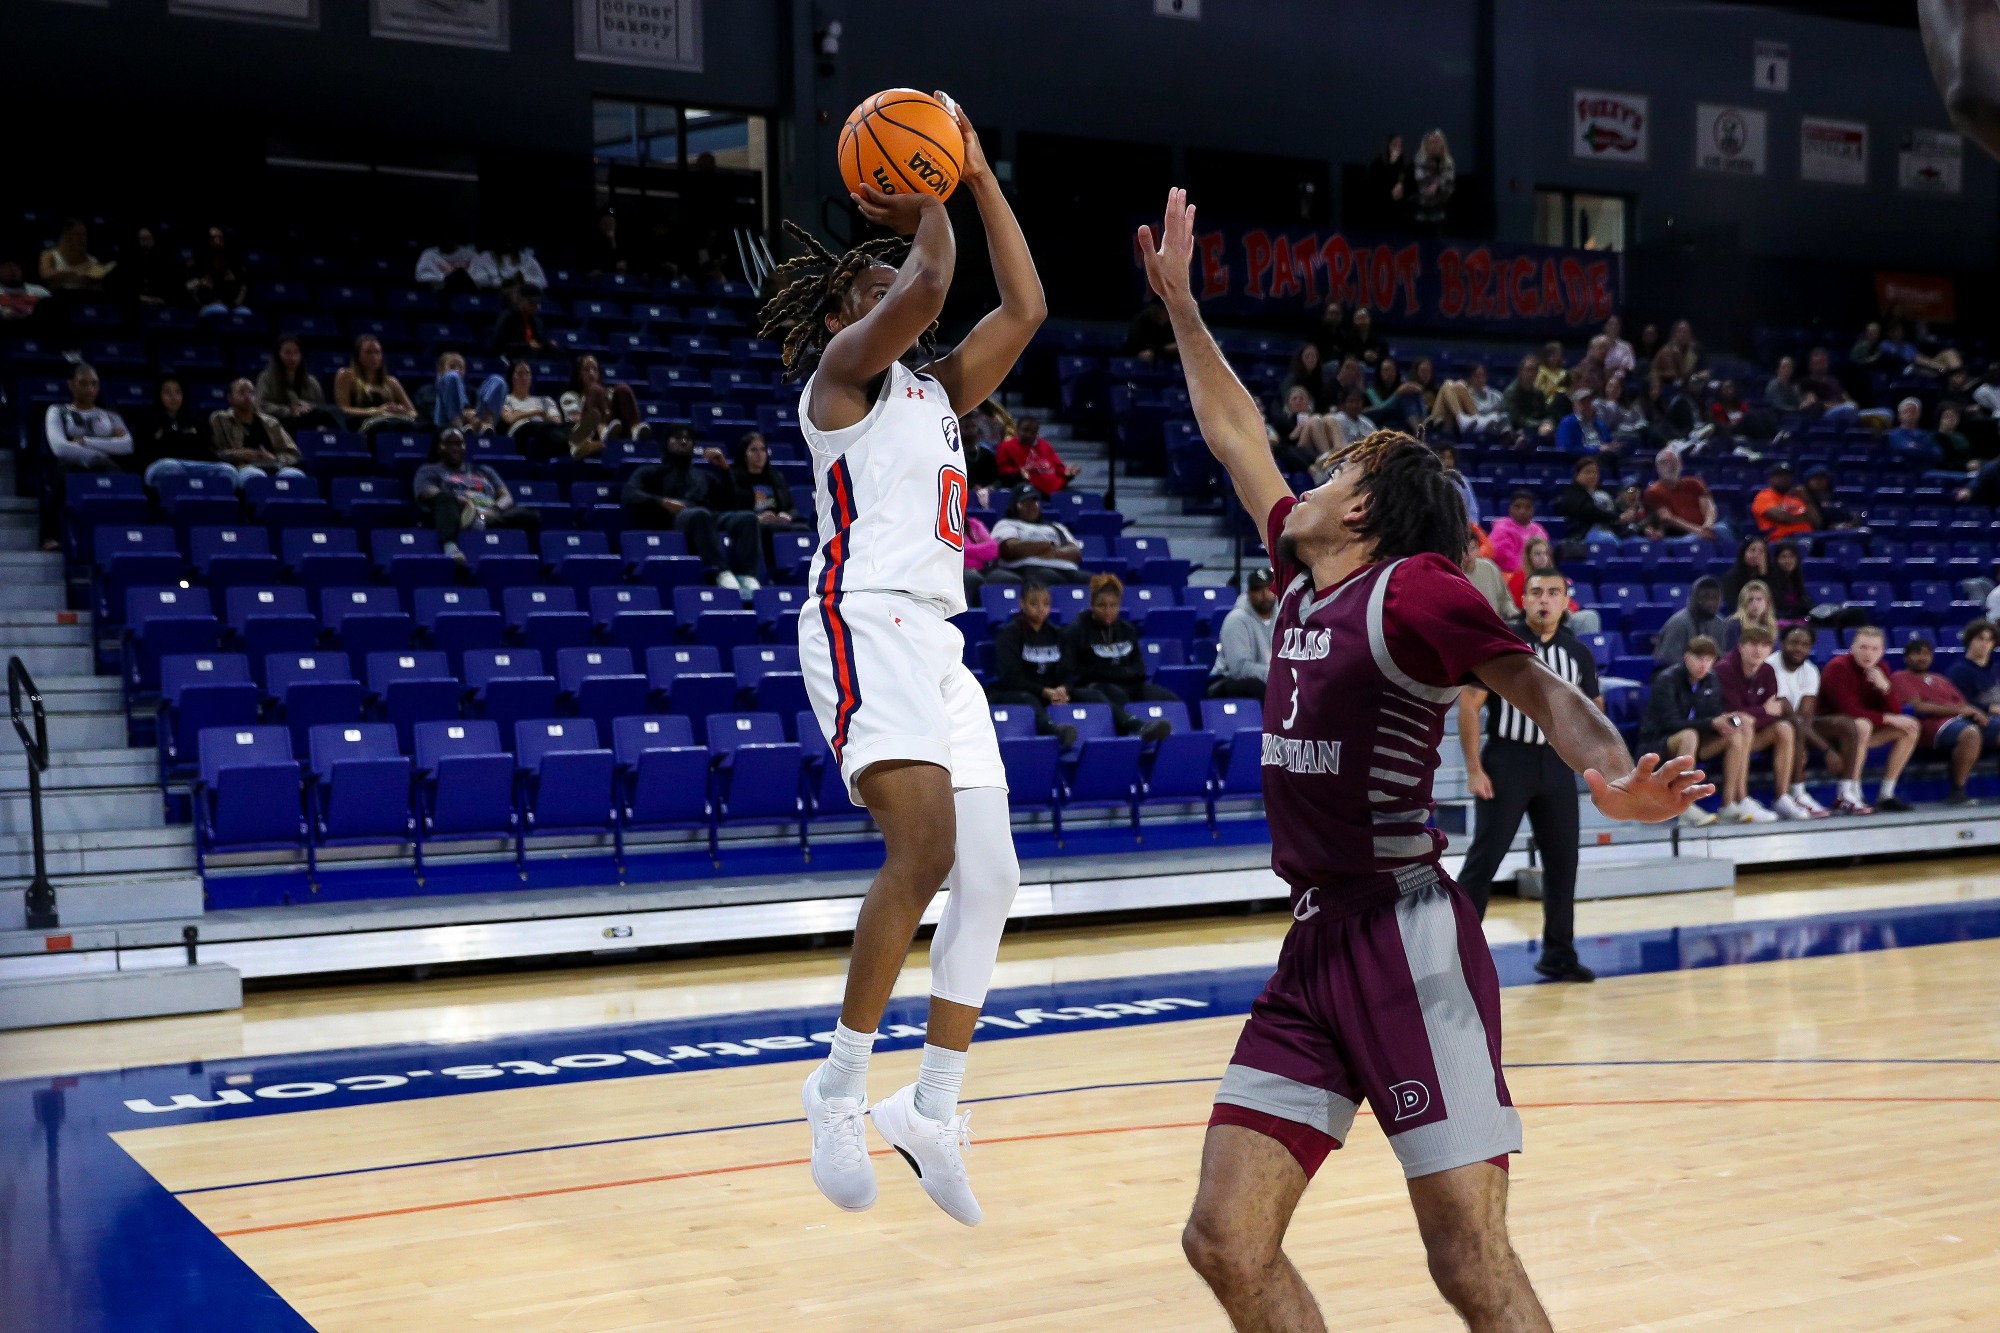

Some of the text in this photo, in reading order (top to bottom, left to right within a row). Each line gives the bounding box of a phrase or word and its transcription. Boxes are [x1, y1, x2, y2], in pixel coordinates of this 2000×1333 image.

[907, 151, 951, 196] NCAA
[1241, 230, 1423, 316] PATRIOT
[1436, 246, 1614, 325] BRIGADE
[123, 997, 1209, 1114] uttylratriots.com
